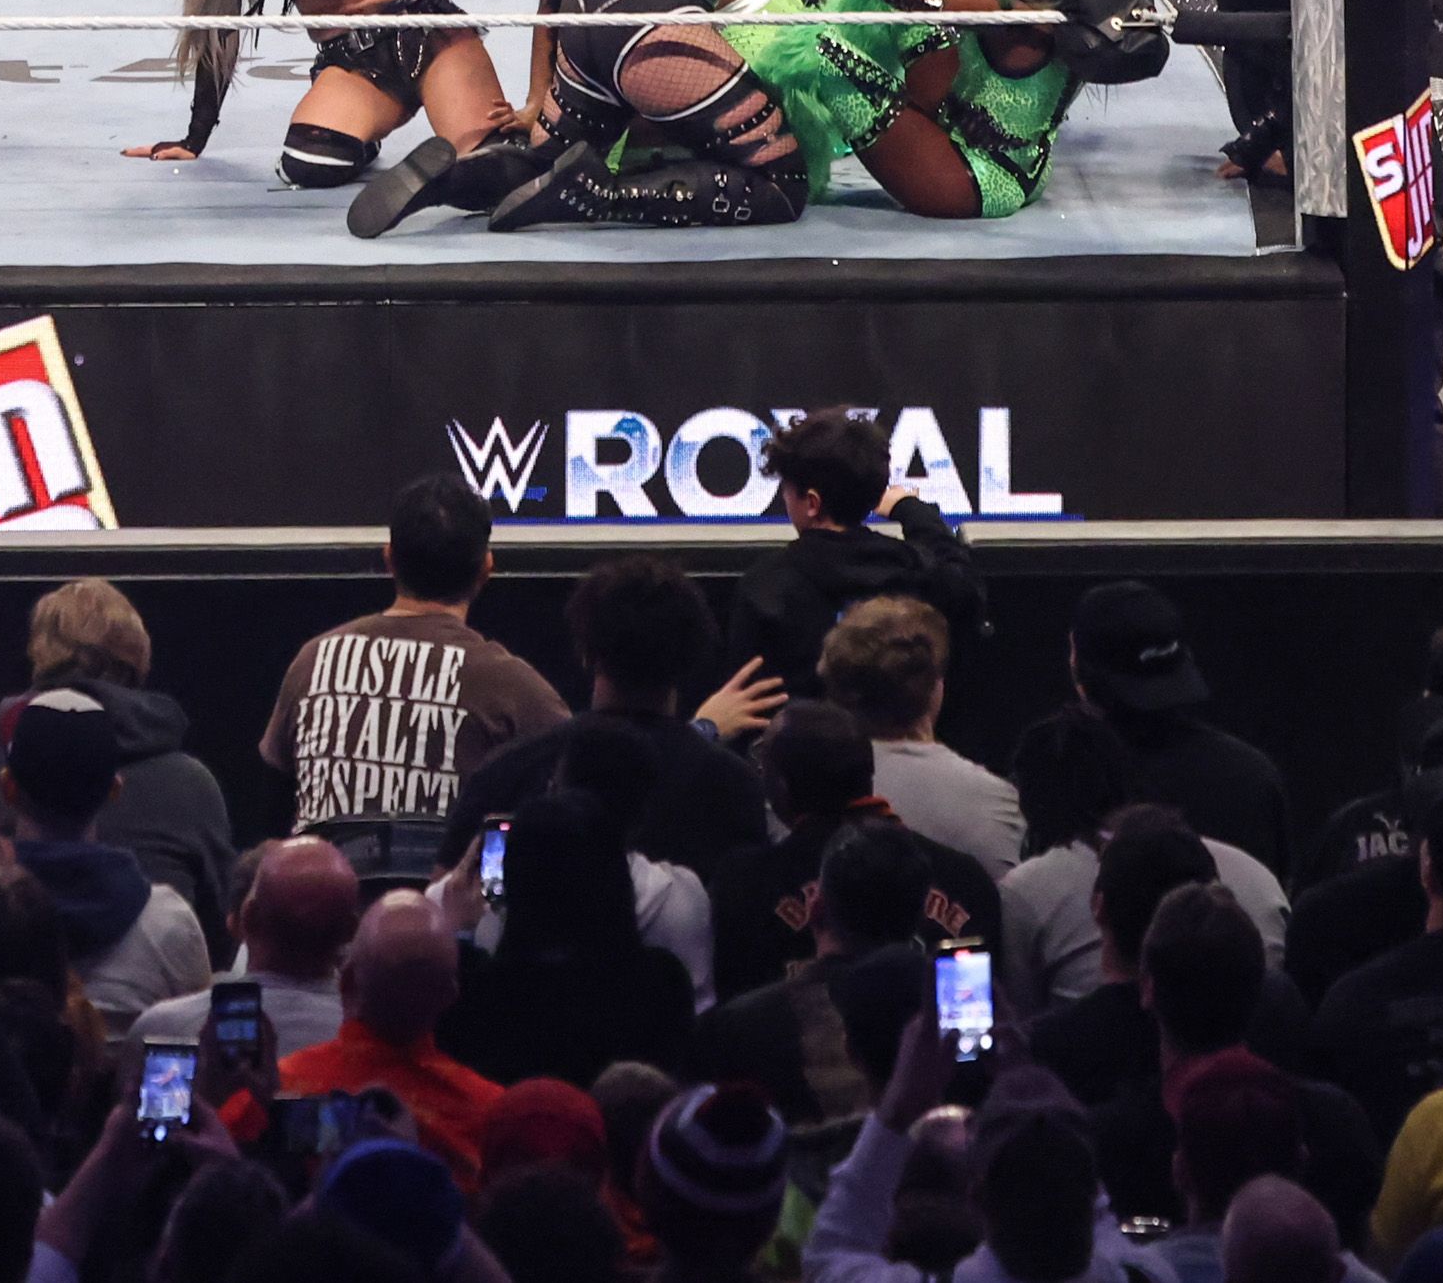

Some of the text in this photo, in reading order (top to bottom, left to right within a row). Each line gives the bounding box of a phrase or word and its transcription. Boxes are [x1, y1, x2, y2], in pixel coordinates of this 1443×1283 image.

[565, 407, 1064, 519] ROAL
[308, 635, 467, 703] HUSTLE
[296, 695, 467, 778] LOYALTY
[293, 754, 461, 832] RESPECT
